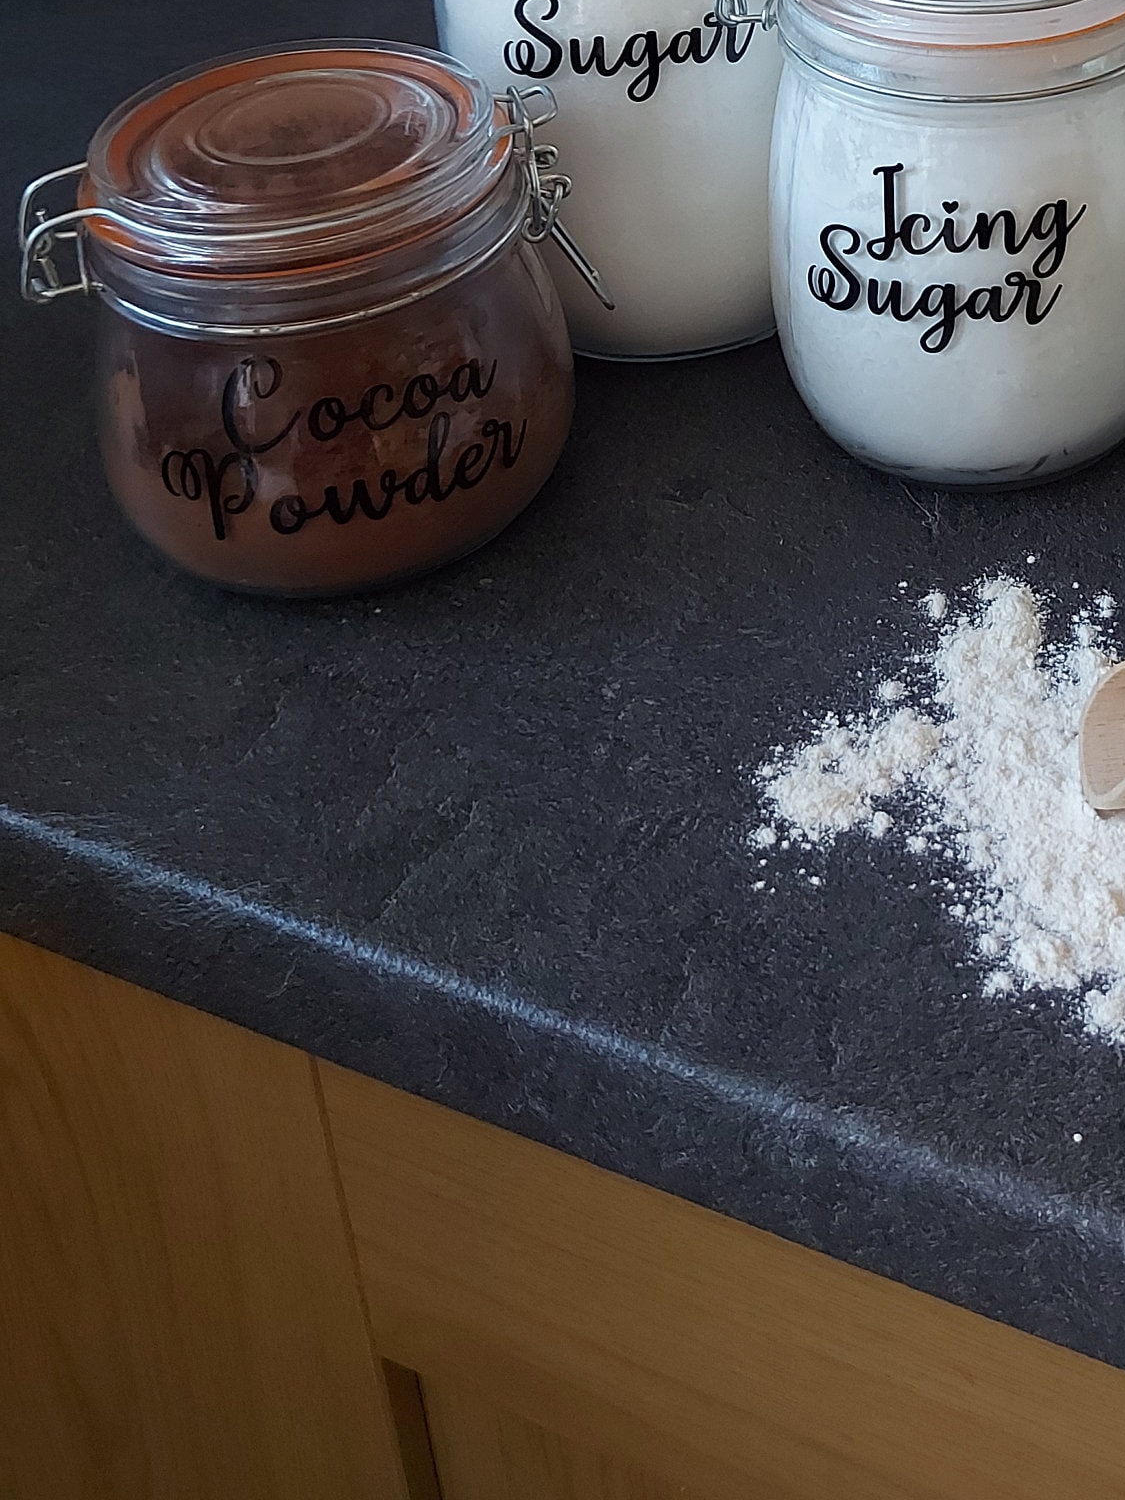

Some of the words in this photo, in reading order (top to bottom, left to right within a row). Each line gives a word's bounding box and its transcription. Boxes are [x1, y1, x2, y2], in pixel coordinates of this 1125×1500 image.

[866, 162, 1087, 279] Icing
[807, 223, 1063, 354] Sugar
[222, 354, 498, 454] Cocoa
[161, 411, 528, 541] Powder
